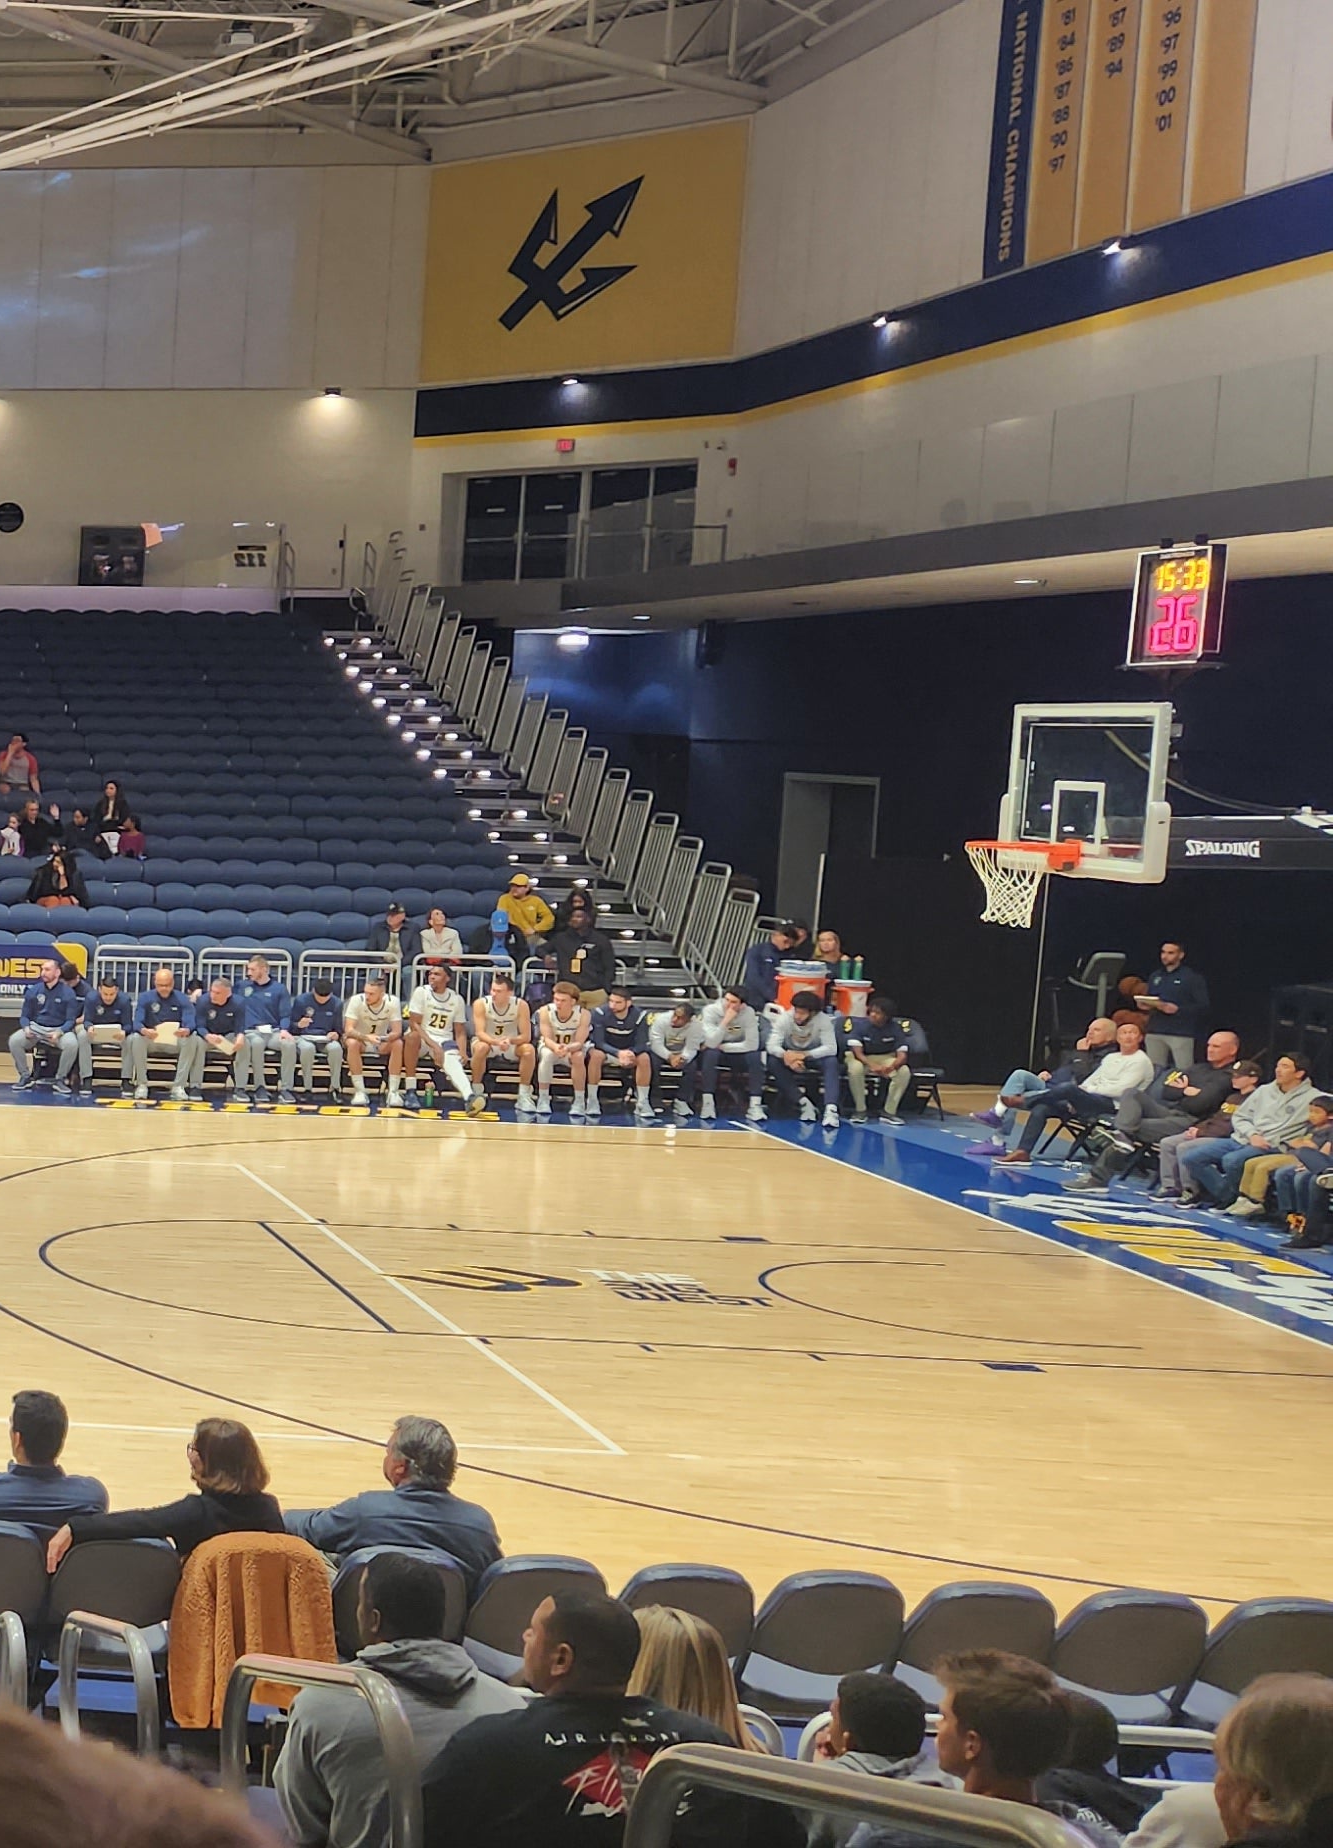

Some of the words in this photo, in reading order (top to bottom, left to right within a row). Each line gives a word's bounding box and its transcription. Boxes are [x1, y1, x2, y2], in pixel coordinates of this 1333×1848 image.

[1061, 8, 1076, 26] '81
[1109, 7, 1127, 27] '87
[1162, 7, 1181, 27] '96
[1058, 32, 1076, 51] '84
[1106, 33, 1125, 52] '89
[1160, 33, 1180, 53] '97
[1009, 11, 1029, 125] NATIONAL
[1056, 57, 1074, 76] '86
[1104, 59, 1123, 78] '94
[1158, 60, 1178, 80] '99
[1054, 81, 1071, 100] '87
[1156, 86, 1176, 106] '00
[1052, 106, 1070, 124] '88
[1155, 113, 1172, 132] '01
[1050, 131, 1068, 149] '90
[1048, 154, 1065, 174] '97
[998, 129, 1021, 262] CHAMPIONS
[1156, 557, 1209, 592] 15:33
[1149, 594, 1198, 653] 26
[1185, 840, 1261, 858] SPALDING
[429, 1013, 447, 1029] 25
[494, 1025, 504, 1036] 3
[554, 1034, 571, 1045] 10
[577, 1269, 705, 1285] THE
[599, 1280, 710, 1295] BIG
[614, 1290, 774, 1307] WEST
